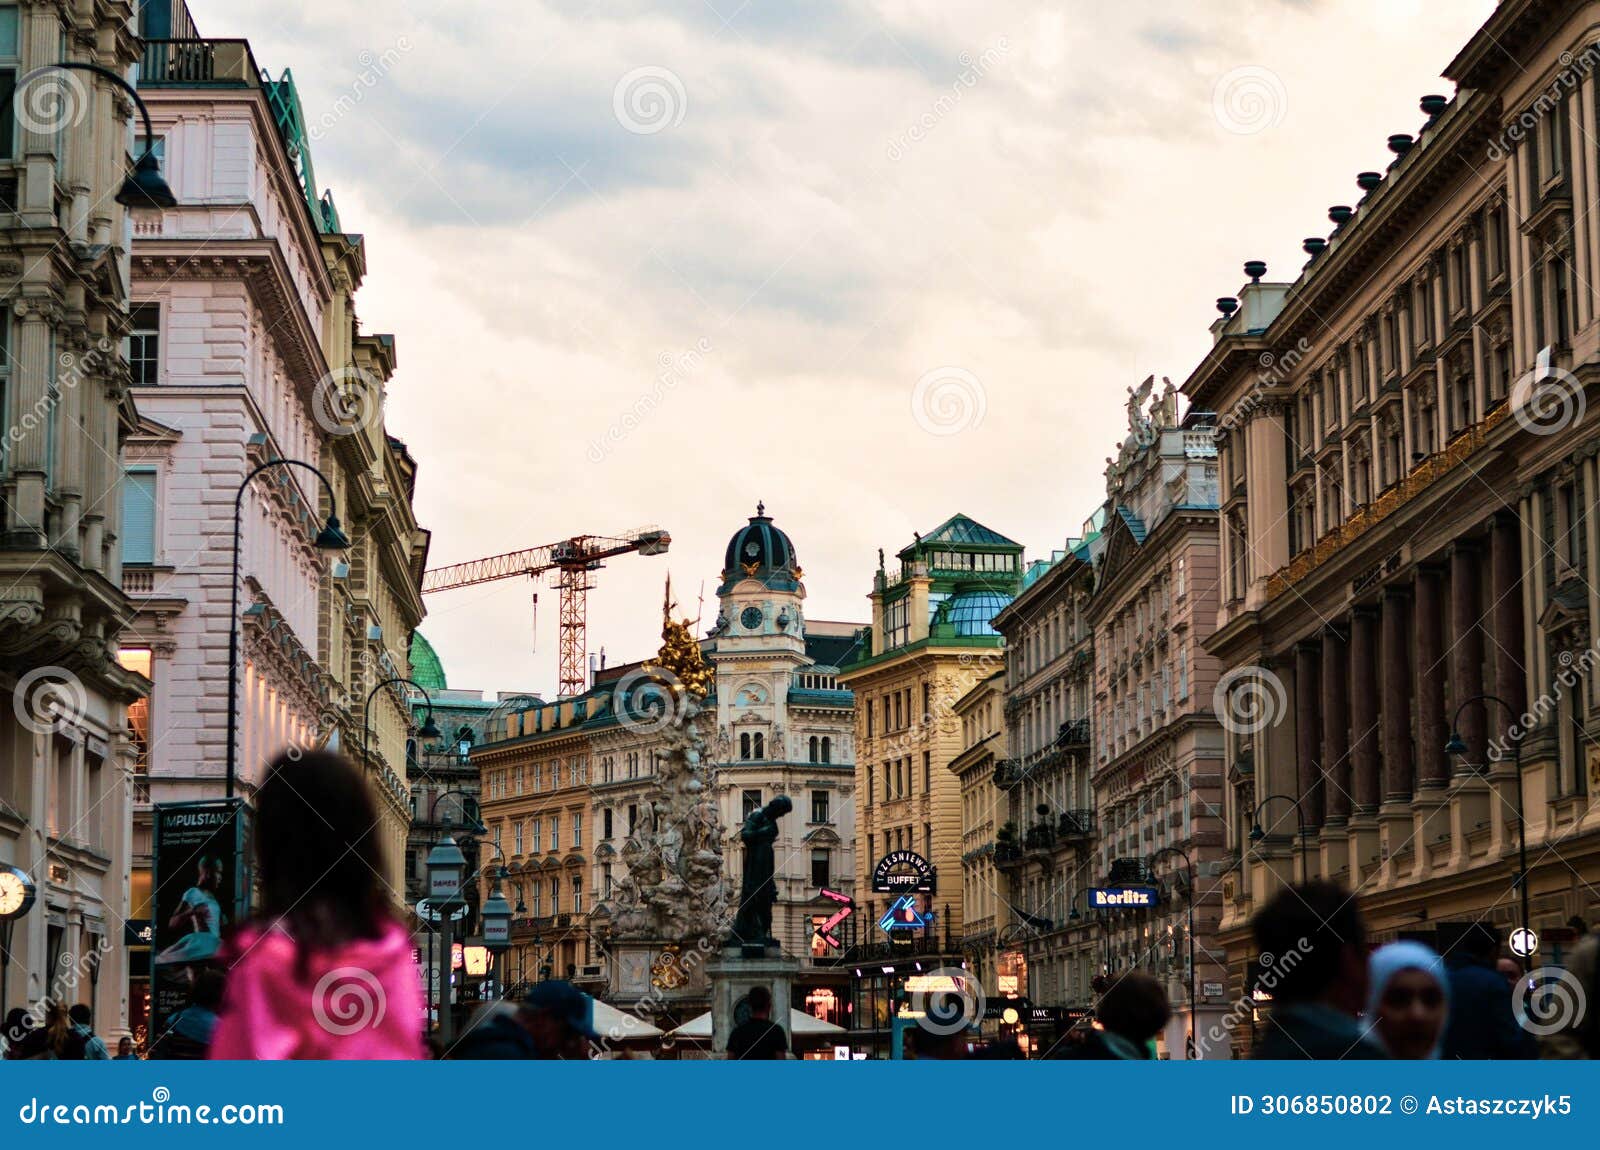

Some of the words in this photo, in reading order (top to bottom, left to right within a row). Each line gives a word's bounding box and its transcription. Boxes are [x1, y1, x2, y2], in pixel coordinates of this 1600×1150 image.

[887, 875, 921, 885] BUFFET
[1096, 889, 1149, 905] Berlitz
[1032, 1009, 1049, 1017] IWC
